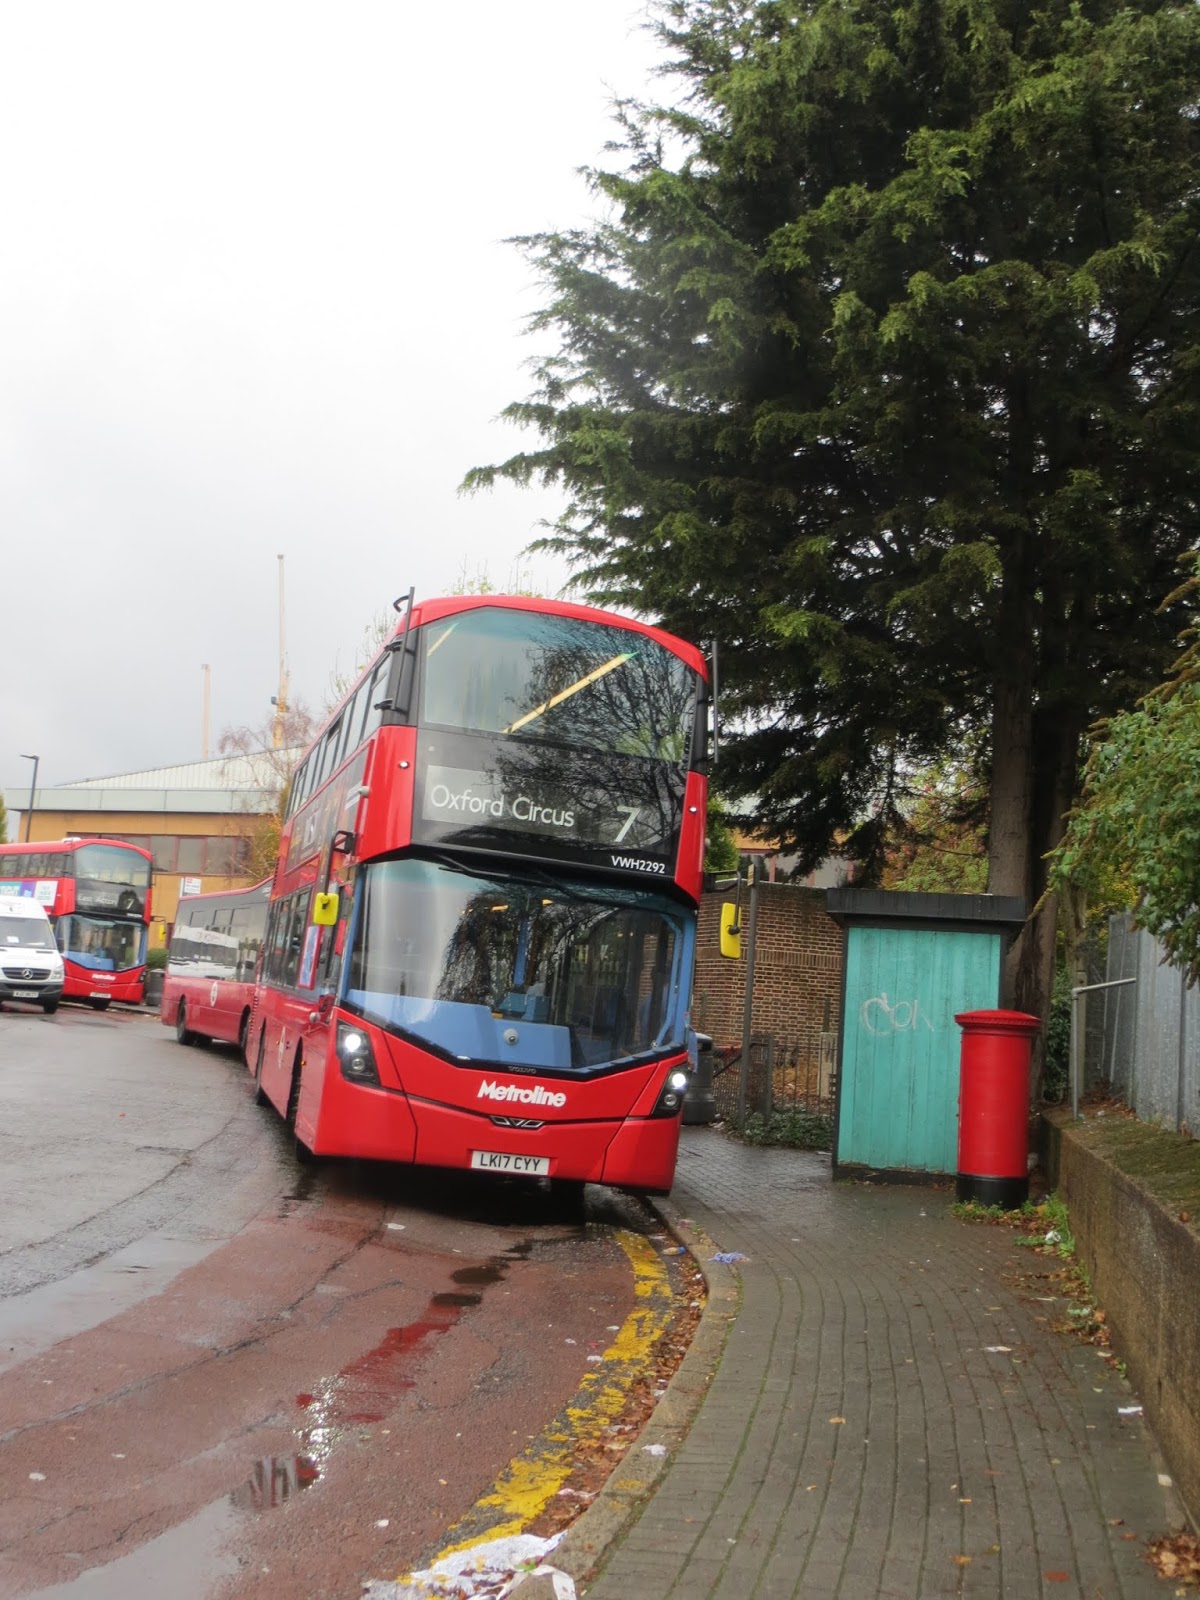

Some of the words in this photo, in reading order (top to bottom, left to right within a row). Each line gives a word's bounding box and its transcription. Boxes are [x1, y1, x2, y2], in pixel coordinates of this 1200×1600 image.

[430, 784, 503, 817] Oxford
[512, 796, 575, 827] Circus
[614, 805, 642, 842] 7
[610, 855, 666, 874] VWH2292
[126, 898, 135, 910] 7
[508, 1065, 537, 1075] VOLVO
[477, 1079, 567, 1108] Metroline
[480, 1153, 511, 1169] LK17
[514, 1156, 541, 1172] CYY
